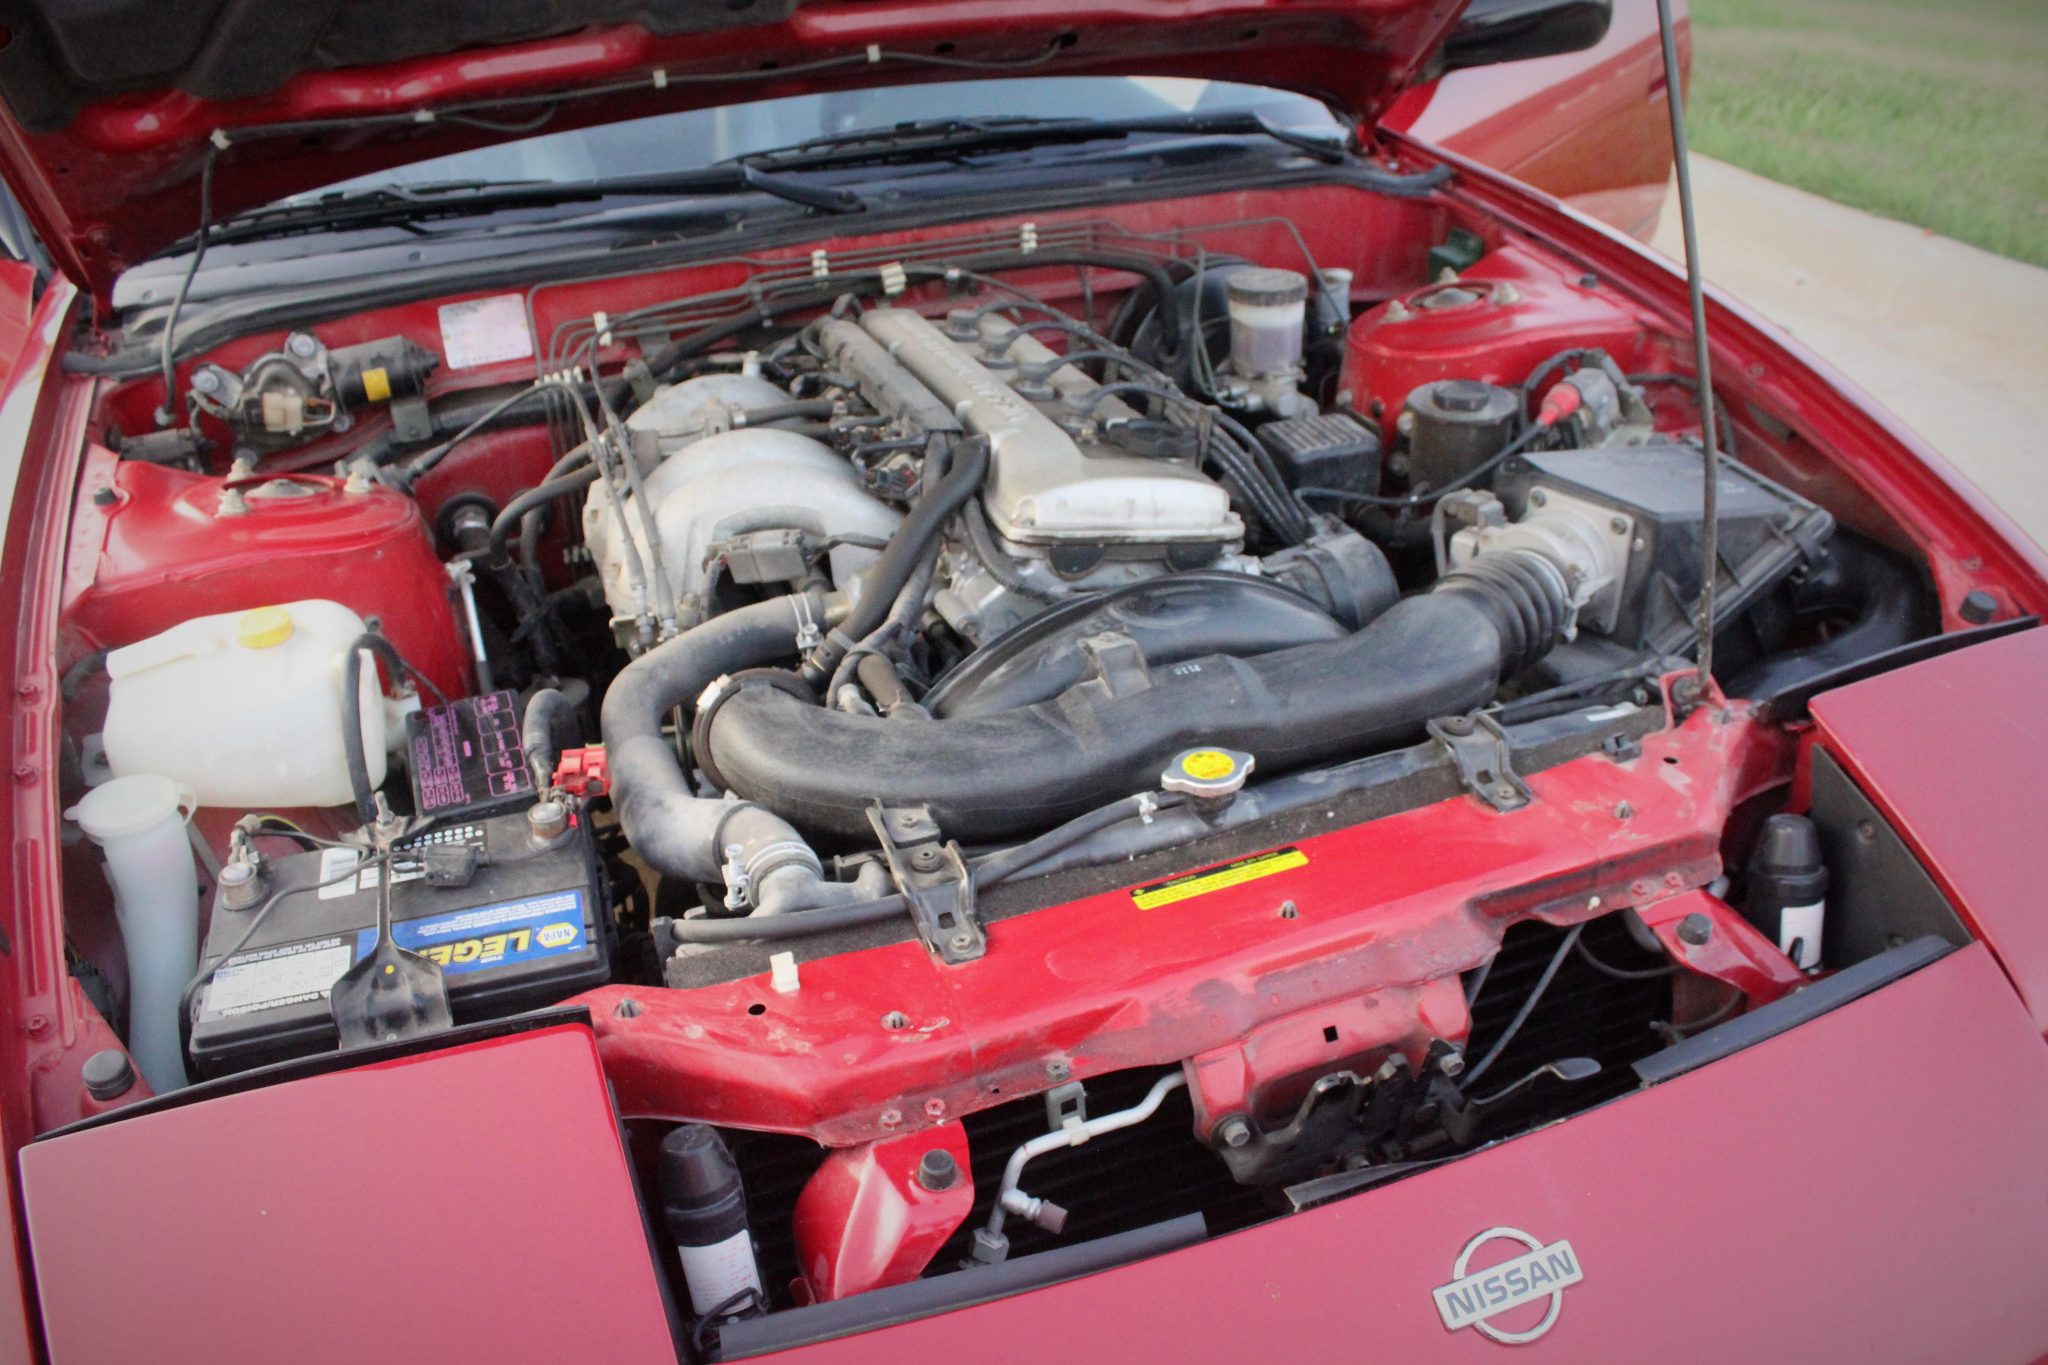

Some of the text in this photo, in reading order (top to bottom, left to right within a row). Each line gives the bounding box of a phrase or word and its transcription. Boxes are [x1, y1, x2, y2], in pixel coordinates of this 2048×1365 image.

[416, 926, 532, 967] LEGE
[542, 923, 574, 946] NAPA
[220, 990, 320, 1018] DANGER/POISON
[1444, 1249, 1576, 1320] NISSAN
